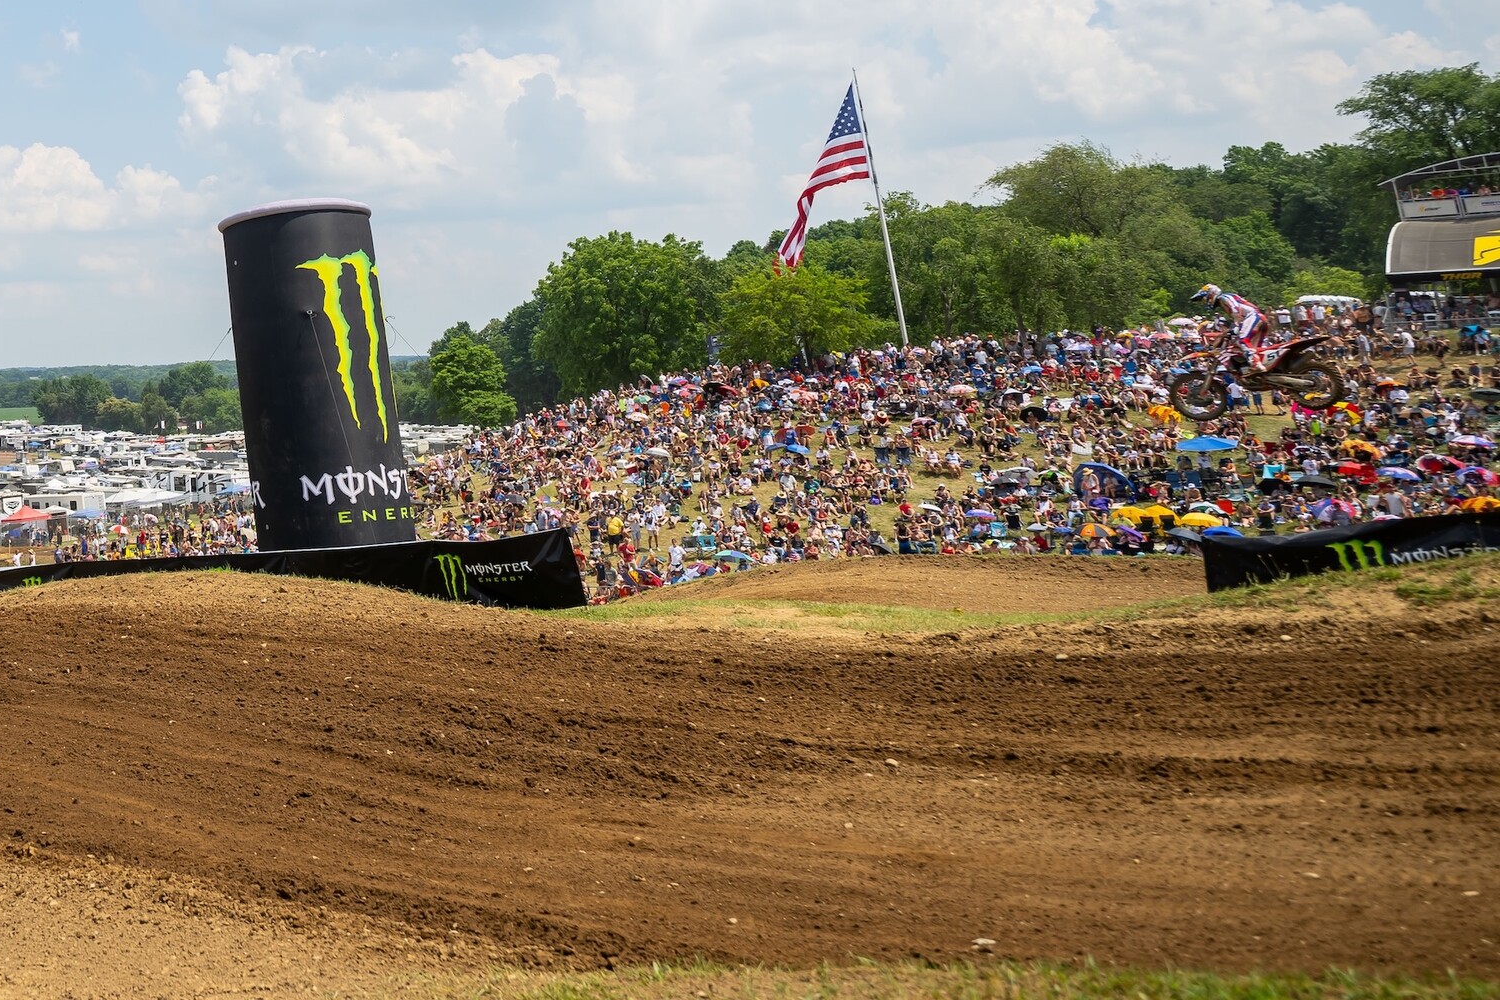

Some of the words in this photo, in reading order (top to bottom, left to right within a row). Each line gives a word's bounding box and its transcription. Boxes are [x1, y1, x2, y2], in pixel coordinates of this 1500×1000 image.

[1440, 272, 1482, 280] THOR
[299, 463, 409, 505] MONST
[338, 507, 414, 524] ENERG
[464, 561, 533, 576] MONSTER
[478, 575, 524, 583] ENERGY
